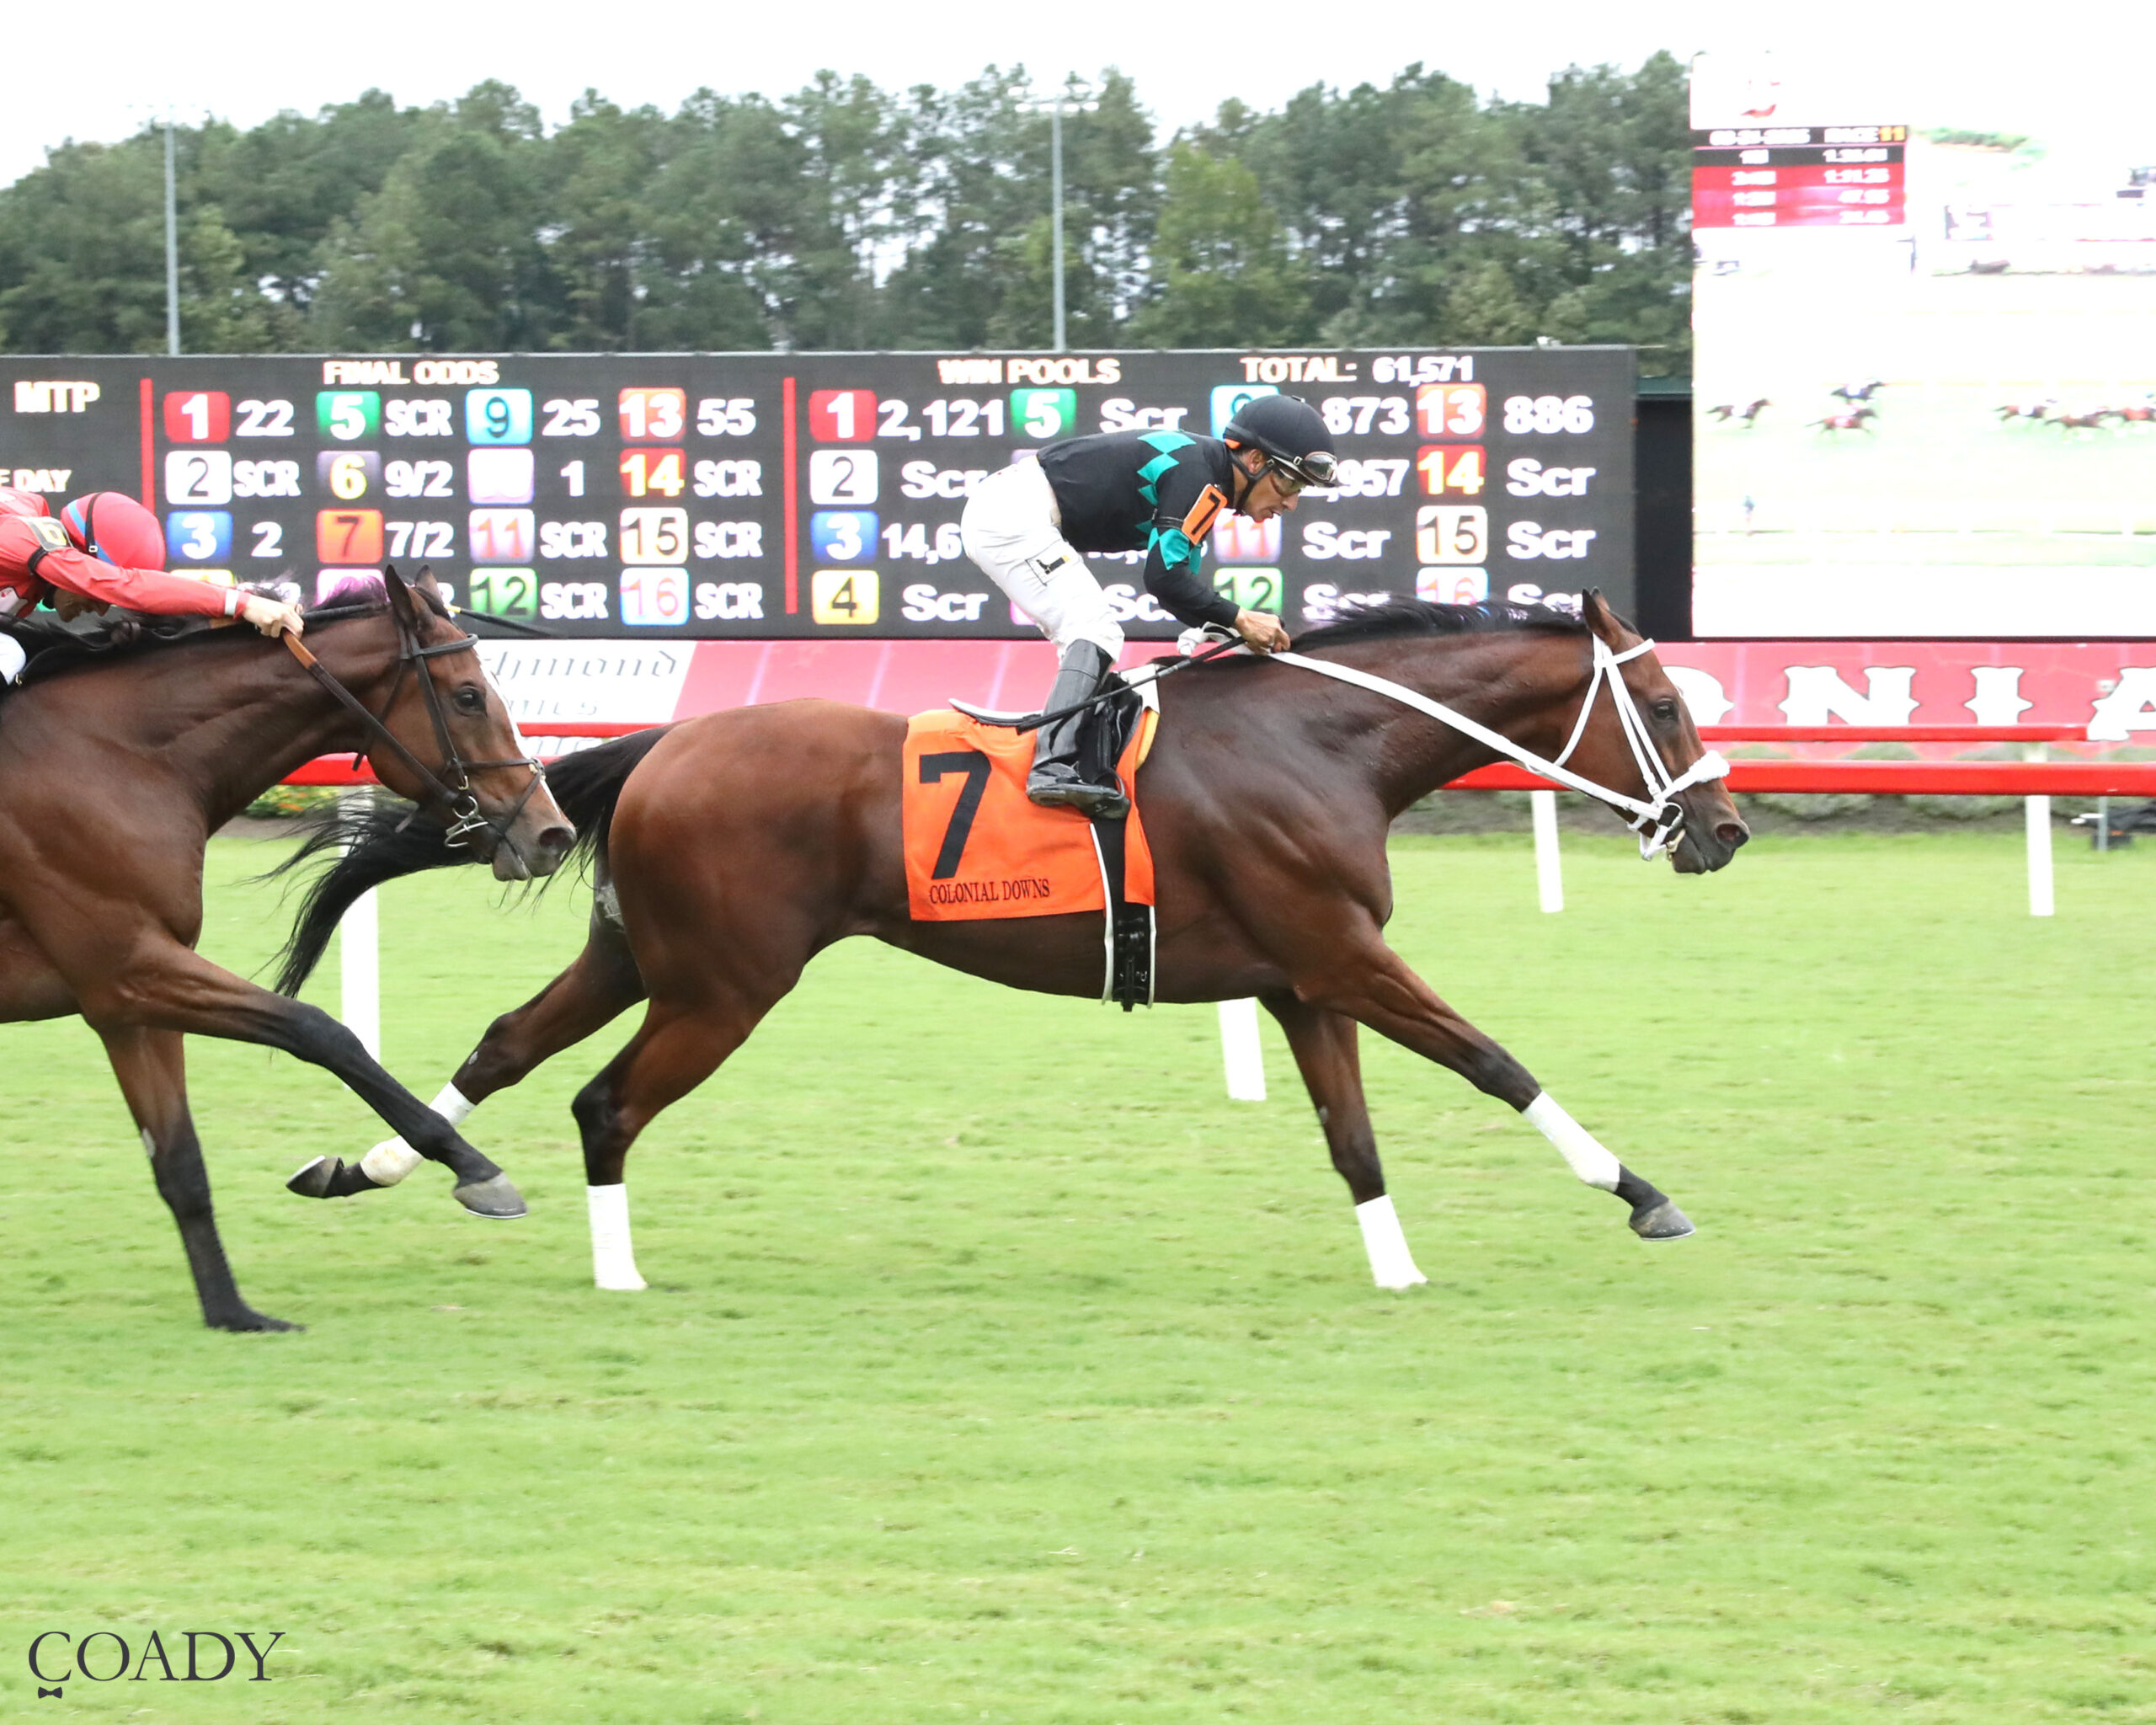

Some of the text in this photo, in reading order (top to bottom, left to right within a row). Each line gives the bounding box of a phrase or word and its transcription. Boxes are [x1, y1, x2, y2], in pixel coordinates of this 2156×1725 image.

[323, 360, 500, 385] FINAL ODDS
[937, 359, 1121, 385] WIN POOLS
[1240, 356, 1474, 387] TOTAL: 61,571
[14, 382, 100, 414] MTP
[181, 393, 757, 441] 1 22 5 SCR 9 25 13 55
[827, 393, 855, 439] 1
[878, 399, 1004, 441] 2,121
[1024, 393, 1062, 438] 5
[1100, 398, 1188, 430] Scr
[1321, 397, 1411, 435] 873
[1418, 388, 1483, 435] 13
[1503, 396, 1594, 435] 886
[13, 468, 72, 493] DAY
[186, 454, 763, 500] 2 SCR 6 9/2 1 14 SCR
[831, 450, 1597, 503] 2 Scr ,957 14 Scr
[181, 513, 764, 560] 3 2 7 7/2 11 SCR 15 SCR
[1191, 492, 1221, 536] 7
[825, 512, 862, 561] 3
[882, 523, 962, 564] 14,6
[1301, 521, 1392, 560] Scr
[1418, 515, 1479, 555] 15
[1506, 521, 1597, 560] Scr
[471, 575, 527, 618] 12
[541, 583, 610, 620] SCR
[621, 577, 680, 617] 16
[695, 583, 765, 620] SCR
[831, 576, 857, 618] 4
[901, 584, 989, 622] Scr
[1105, 584, 1177, 622] Sc
[483, 650, 677, 681] hmond
[919, 751, 992, 880] 7
[929, 879, 1051, 905] COLONIAL DOWNS
